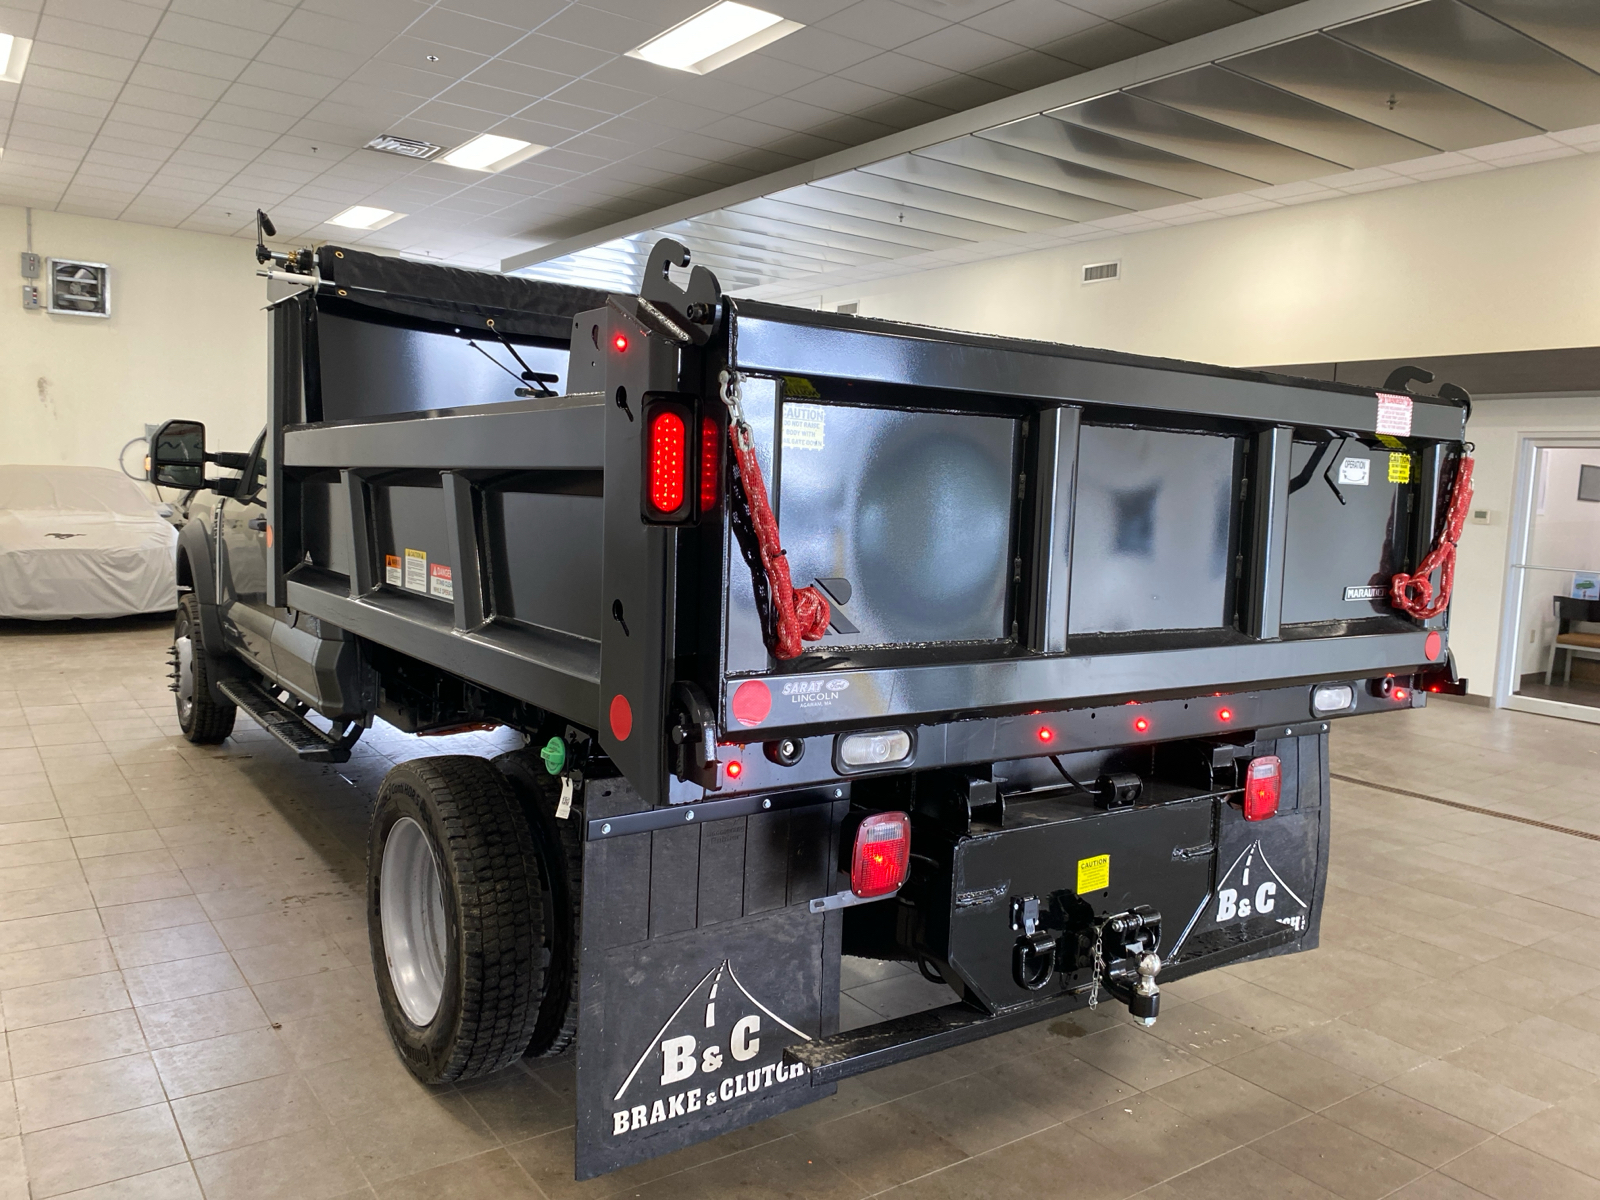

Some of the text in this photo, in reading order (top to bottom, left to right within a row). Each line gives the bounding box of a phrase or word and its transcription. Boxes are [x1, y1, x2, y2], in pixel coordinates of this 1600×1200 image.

[1344, 460, 1366, 470] OPERATION
[782, 680, 824, 695] SARAT
[791, 691, 839, 703] LINCOLN
[1081, 858, 1107, 869] CAUTION
[612, 1088, 701, 1136] BRAKE
[706, 1092, 718, 1106] &
